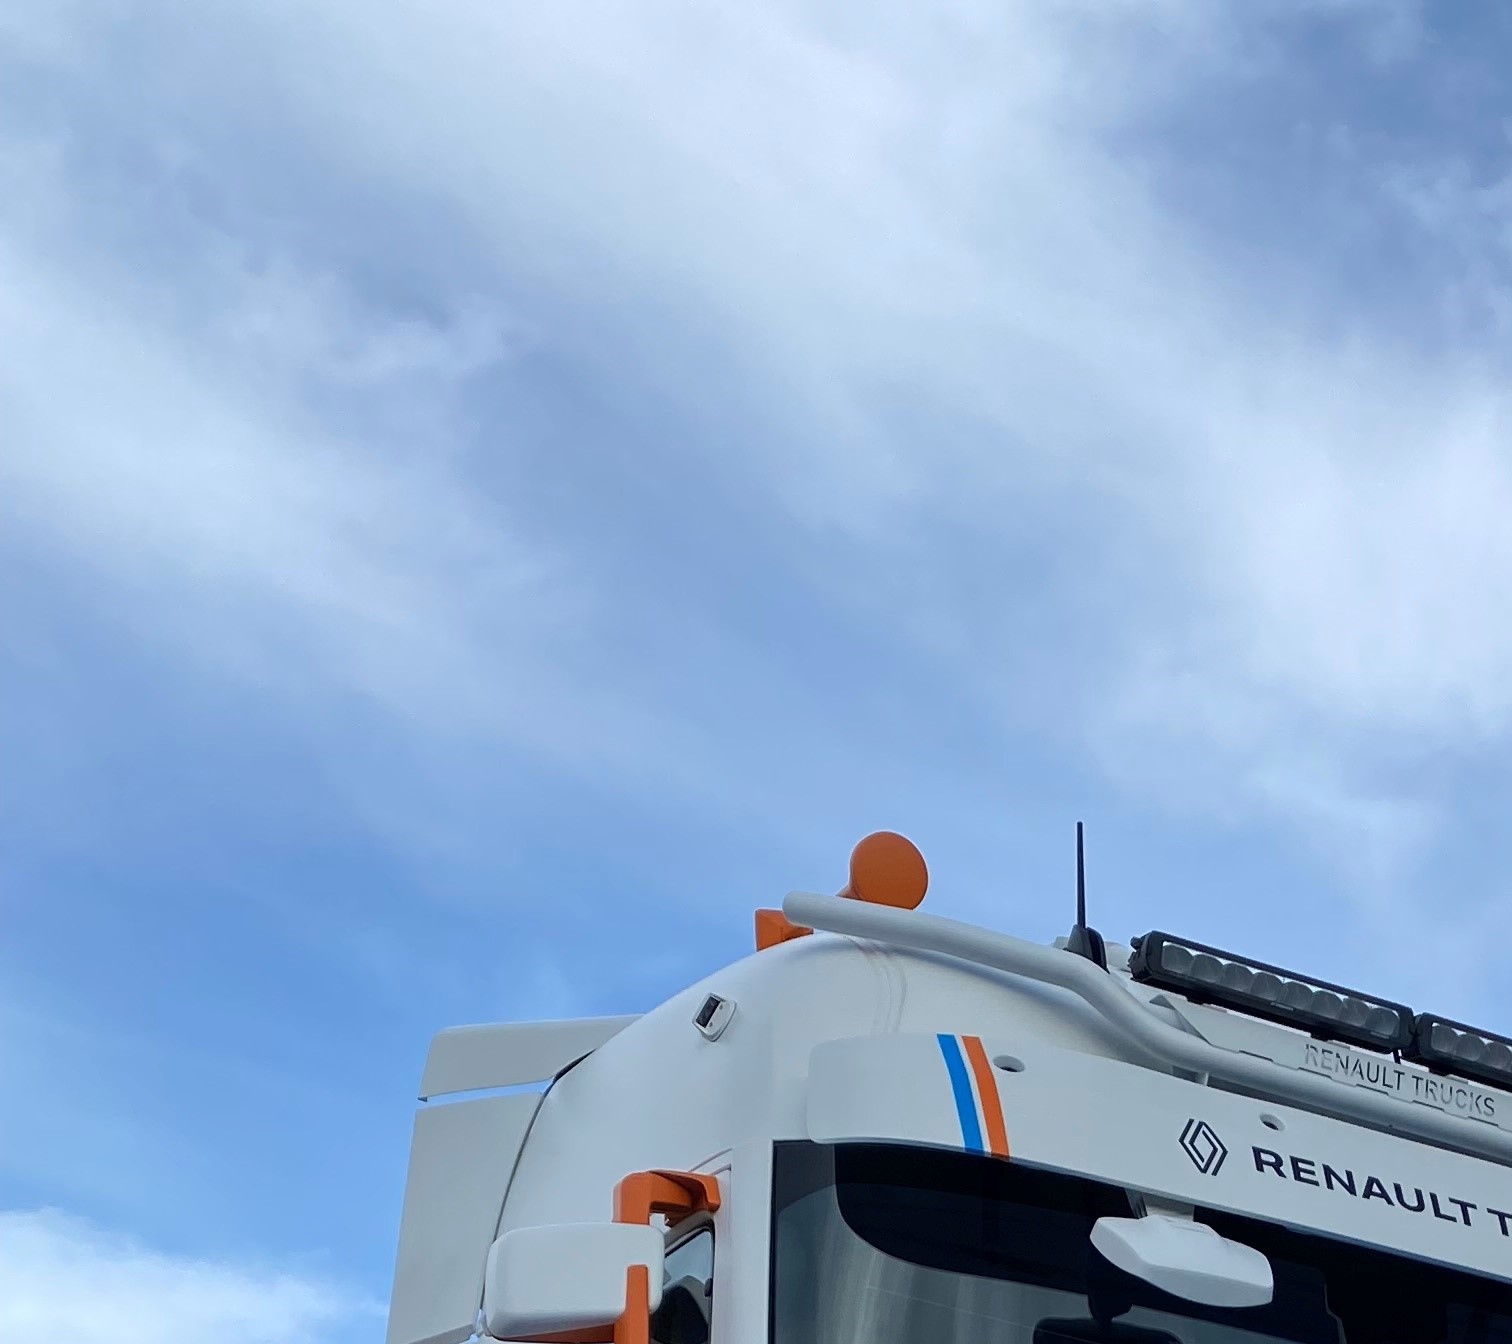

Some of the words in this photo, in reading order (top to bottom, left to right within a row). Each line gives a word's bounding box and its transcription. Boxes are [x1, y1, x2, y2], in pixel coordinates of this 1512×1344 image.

[1304, 1043, 1405, 1091] RENAULT
[1411, 1074, 1495, 1117] TRUCKS
[1251, 1145, 1478, 1227] RENAULT
